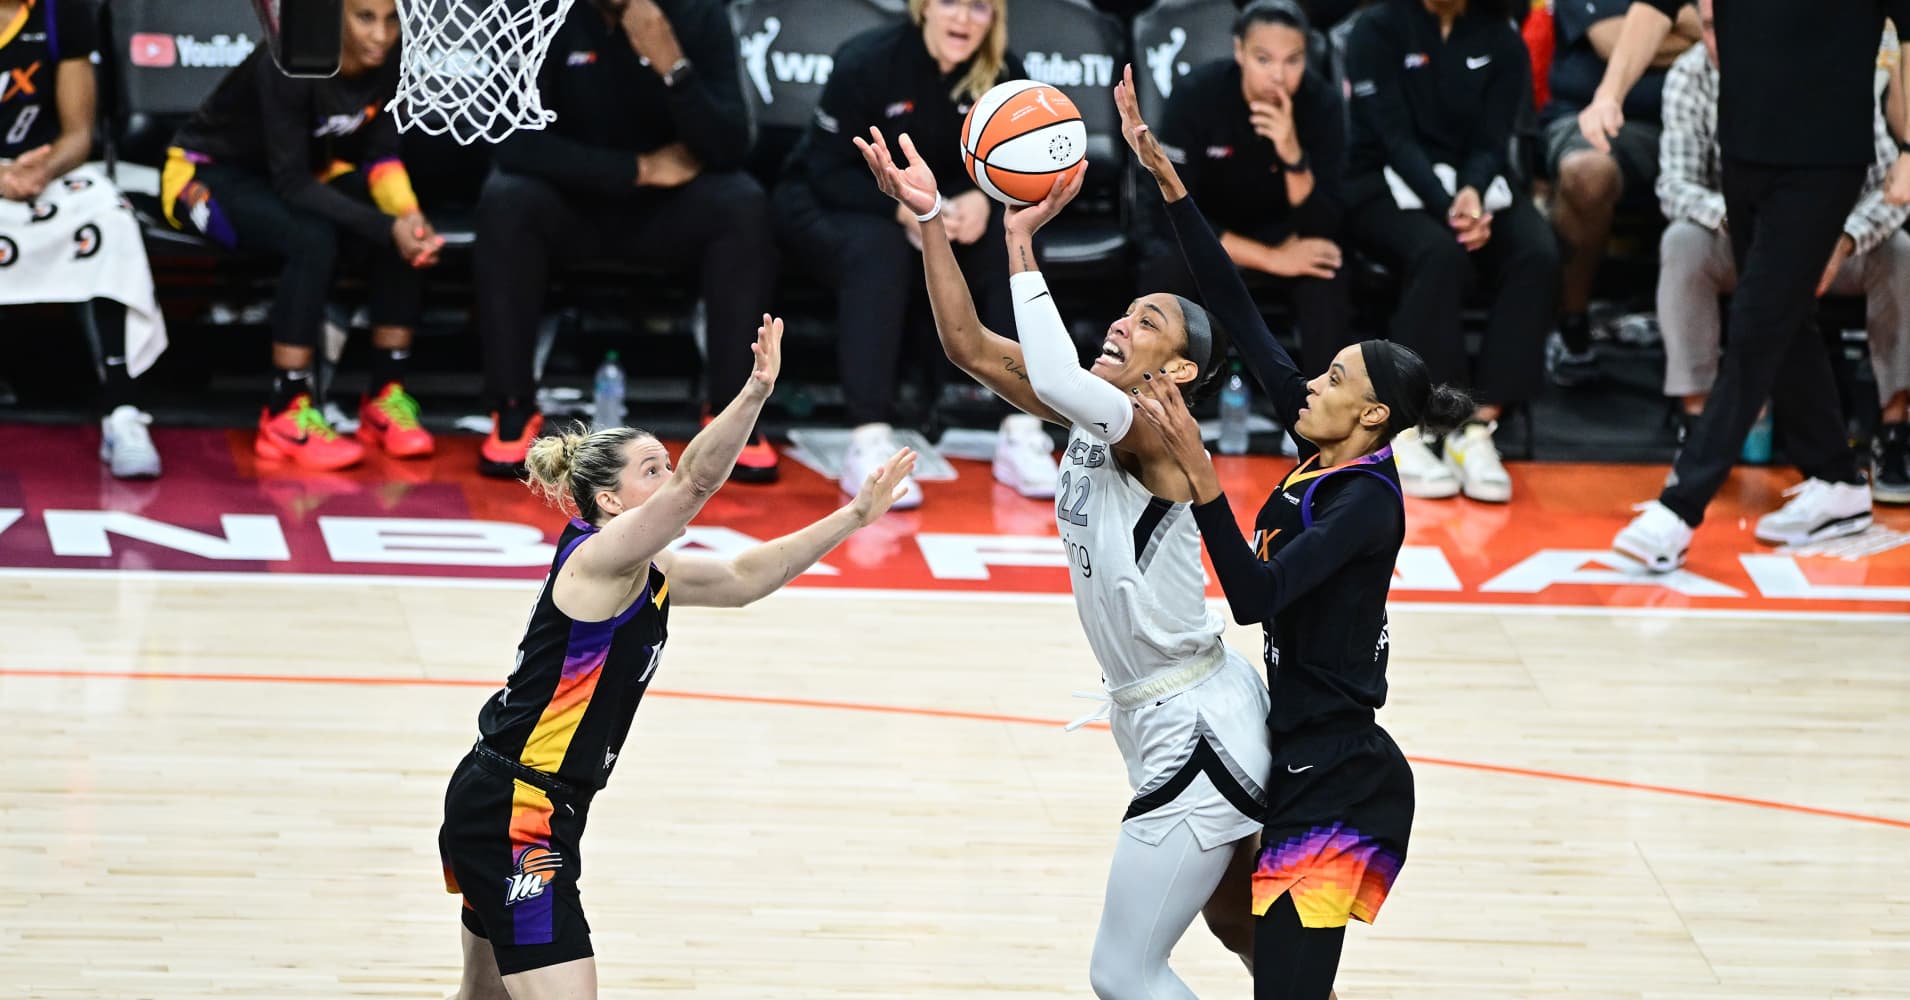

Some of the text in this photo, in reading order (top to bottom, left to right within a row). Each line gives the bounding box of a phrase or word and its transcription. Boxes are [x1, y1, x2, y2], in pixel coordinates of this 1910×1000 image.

[176, 33, 255, 67] YouTub
[1057, 470, 1091, 527] 22
[0, 508, 838, 574] NBA
